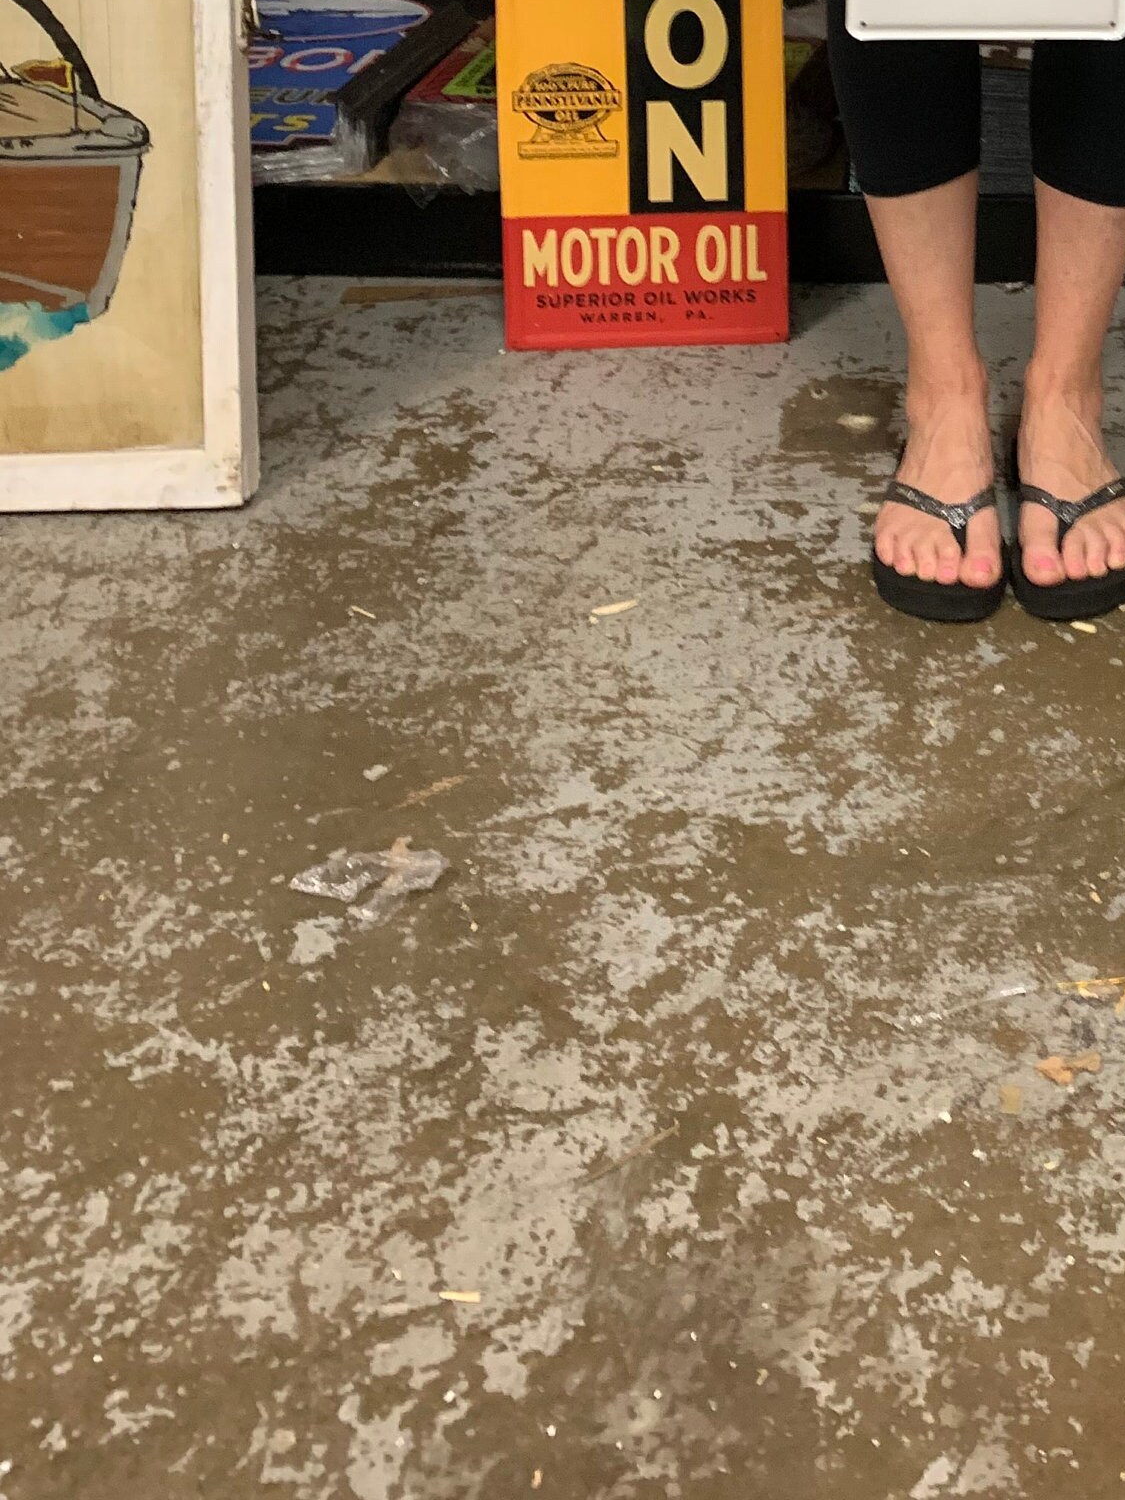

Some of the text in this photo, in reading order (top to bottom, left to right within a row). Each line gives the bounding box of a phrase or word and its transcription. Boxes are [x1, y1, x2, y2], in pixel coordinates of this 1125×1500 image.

[516, 91, 619, 107] PENNSYLVANIA
[521, 223, 768, 288] MOTOR OIL
[535, 288, 757, 309] SUPERIOR OIL WORKS
[579, 309, 715, 324] WARREN, PA.
